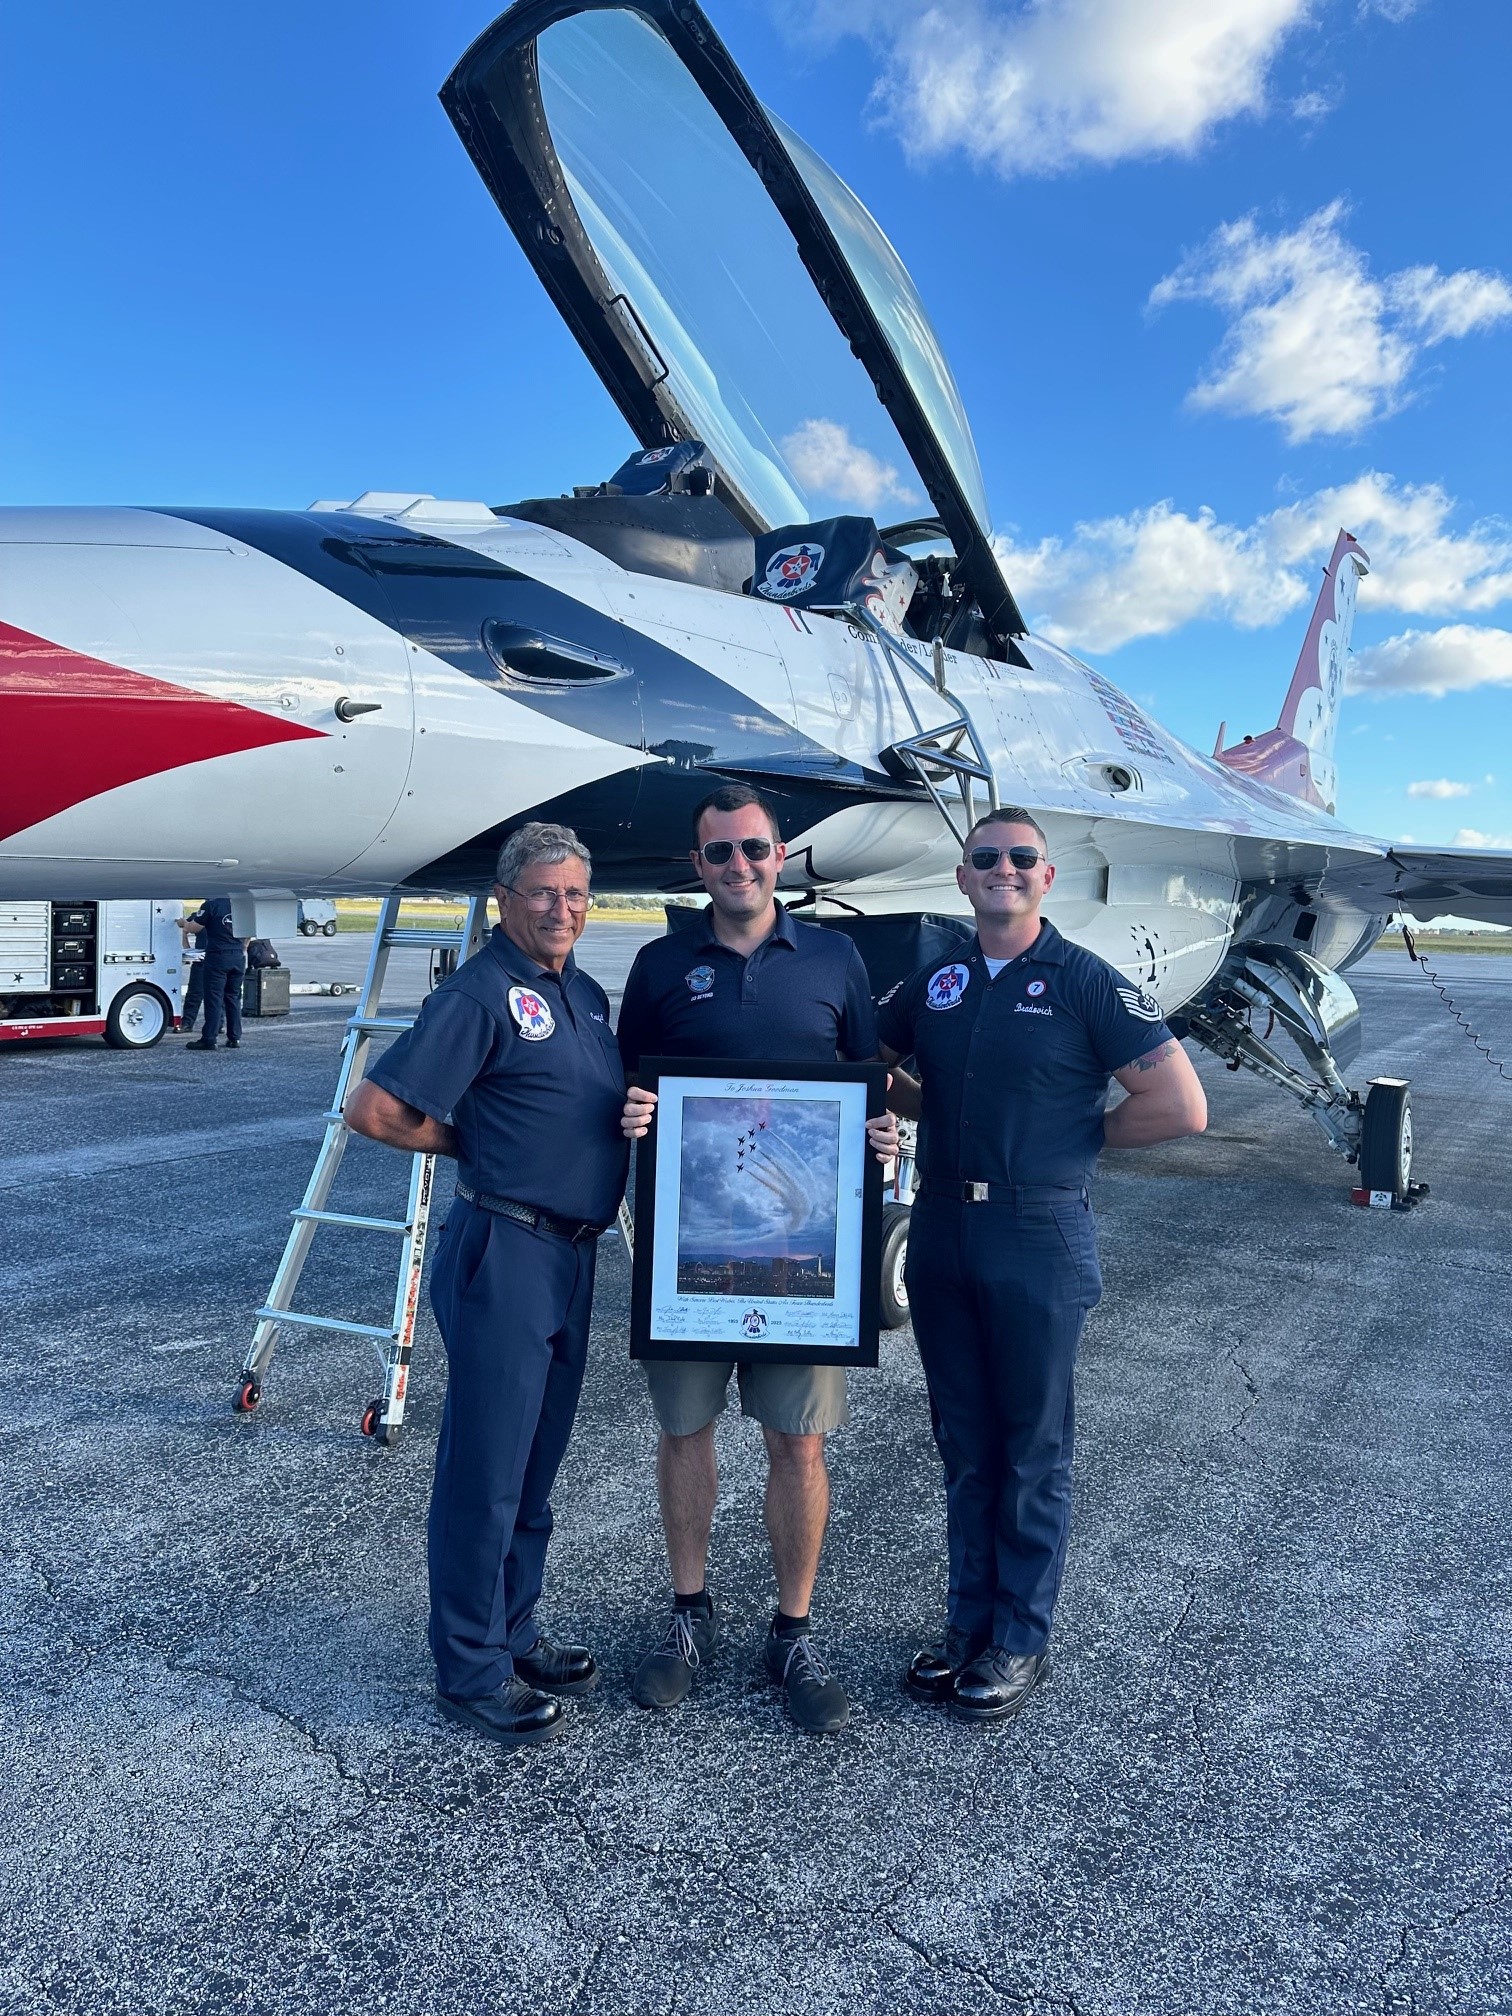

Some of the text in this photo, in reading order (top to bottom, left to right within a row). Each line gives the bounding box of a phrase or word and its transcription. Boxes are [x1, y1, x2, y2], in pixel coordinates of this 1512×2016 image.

[760, 581, 812, 599] Thunderbirds
[1033, 984, 1041, 993] 7
[1013, 1002, 1054, 1016] Bradovich
[724, 1083, 799, 1093] To Joshua Goodman
